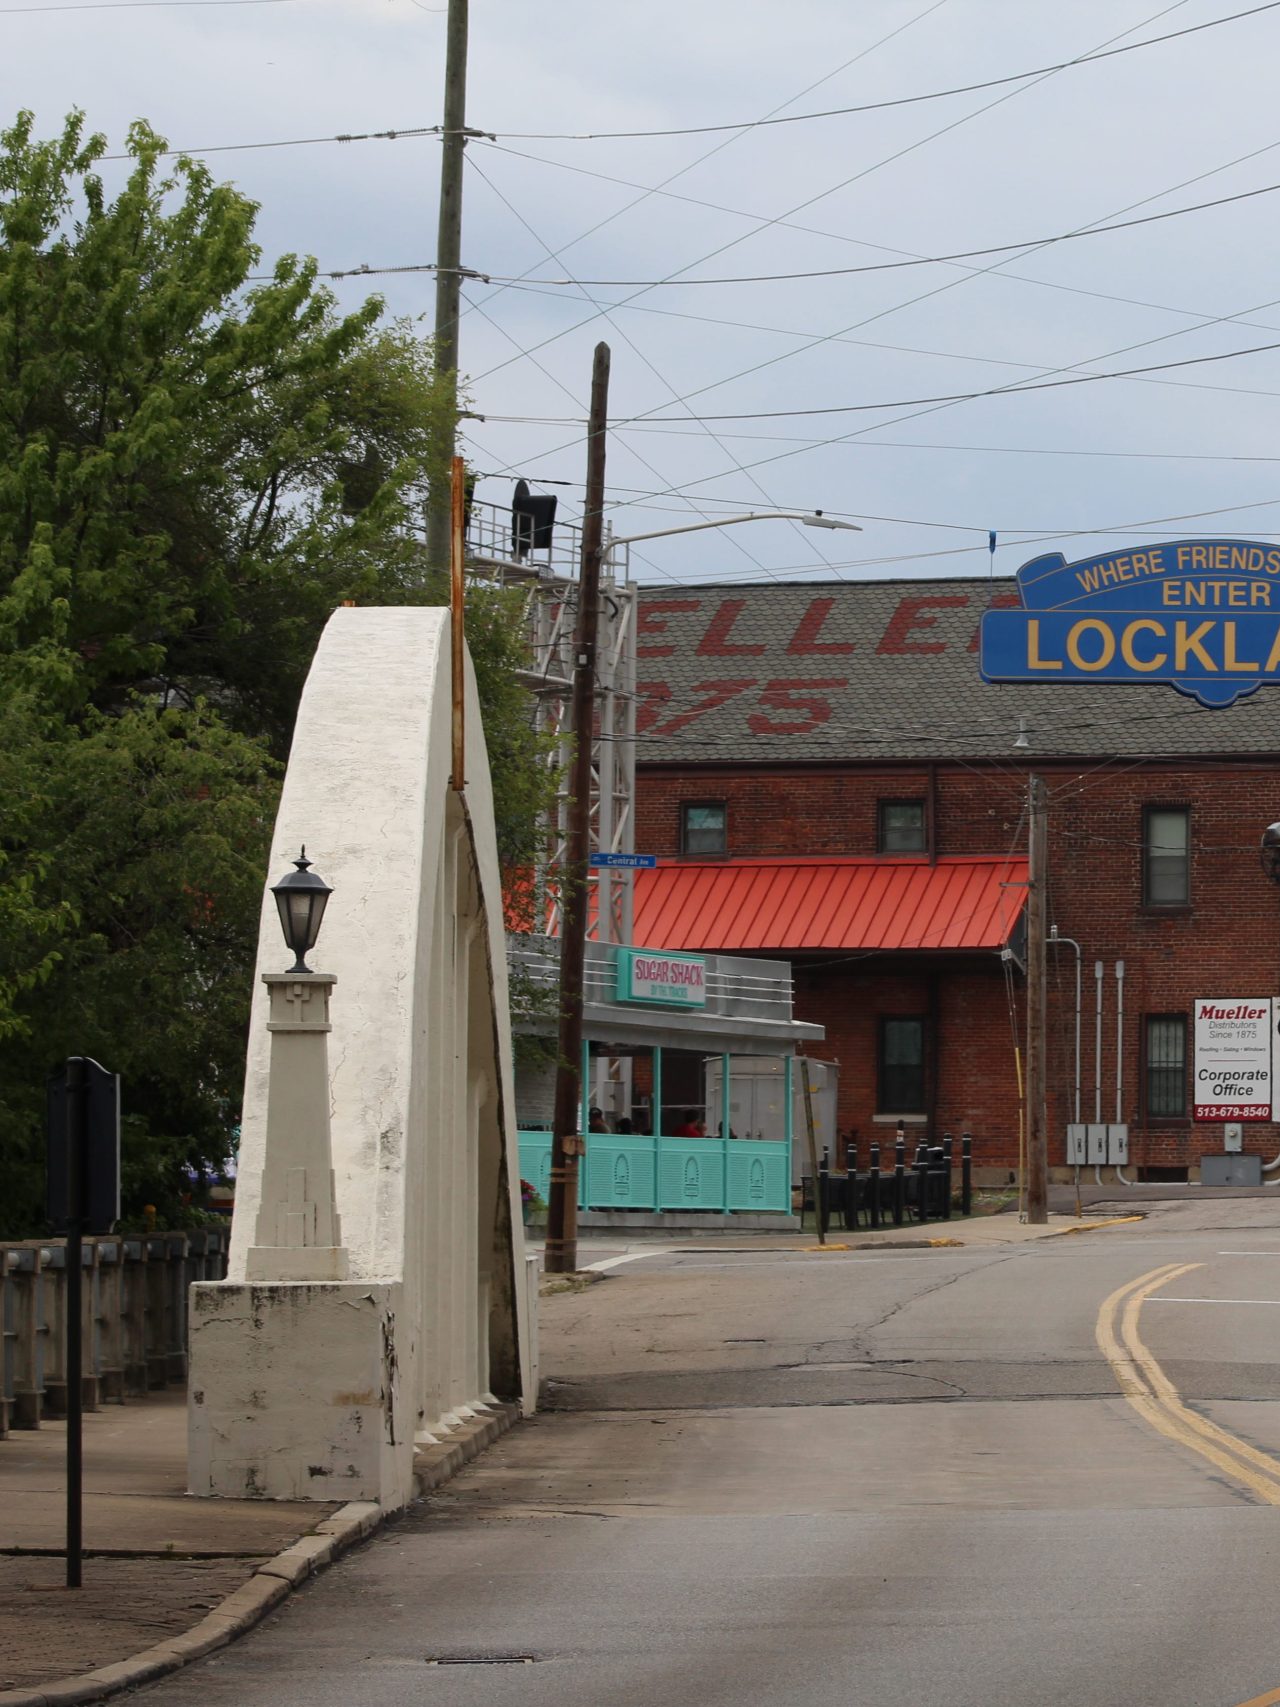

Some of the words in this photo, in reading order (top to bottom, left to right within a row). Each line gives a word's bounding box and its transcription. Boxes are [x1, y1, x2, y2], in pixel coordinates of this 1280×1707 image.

[1076, 550, 1165, 593] WHERE
[1162, 581, 1271, 607] ENTER
[607, 856, 637, 866] Central
[635, 959, 669, 982] SUGAR
[671, 963, 703, 986] SHACK
[1198, 1005, 1267, 1020] Mueller
[1208, 1020, 1257, 1029] Distributors
[1209, 1030, 1232, 1039] Since
[1236, 1030, 1257, 1039] 1875
[1198, 1069, 1268, 1083] Corporate
[1212, 1084, 1254, 1096] Office
[1197, 1107, 1269, 1117] 513-679-8540
